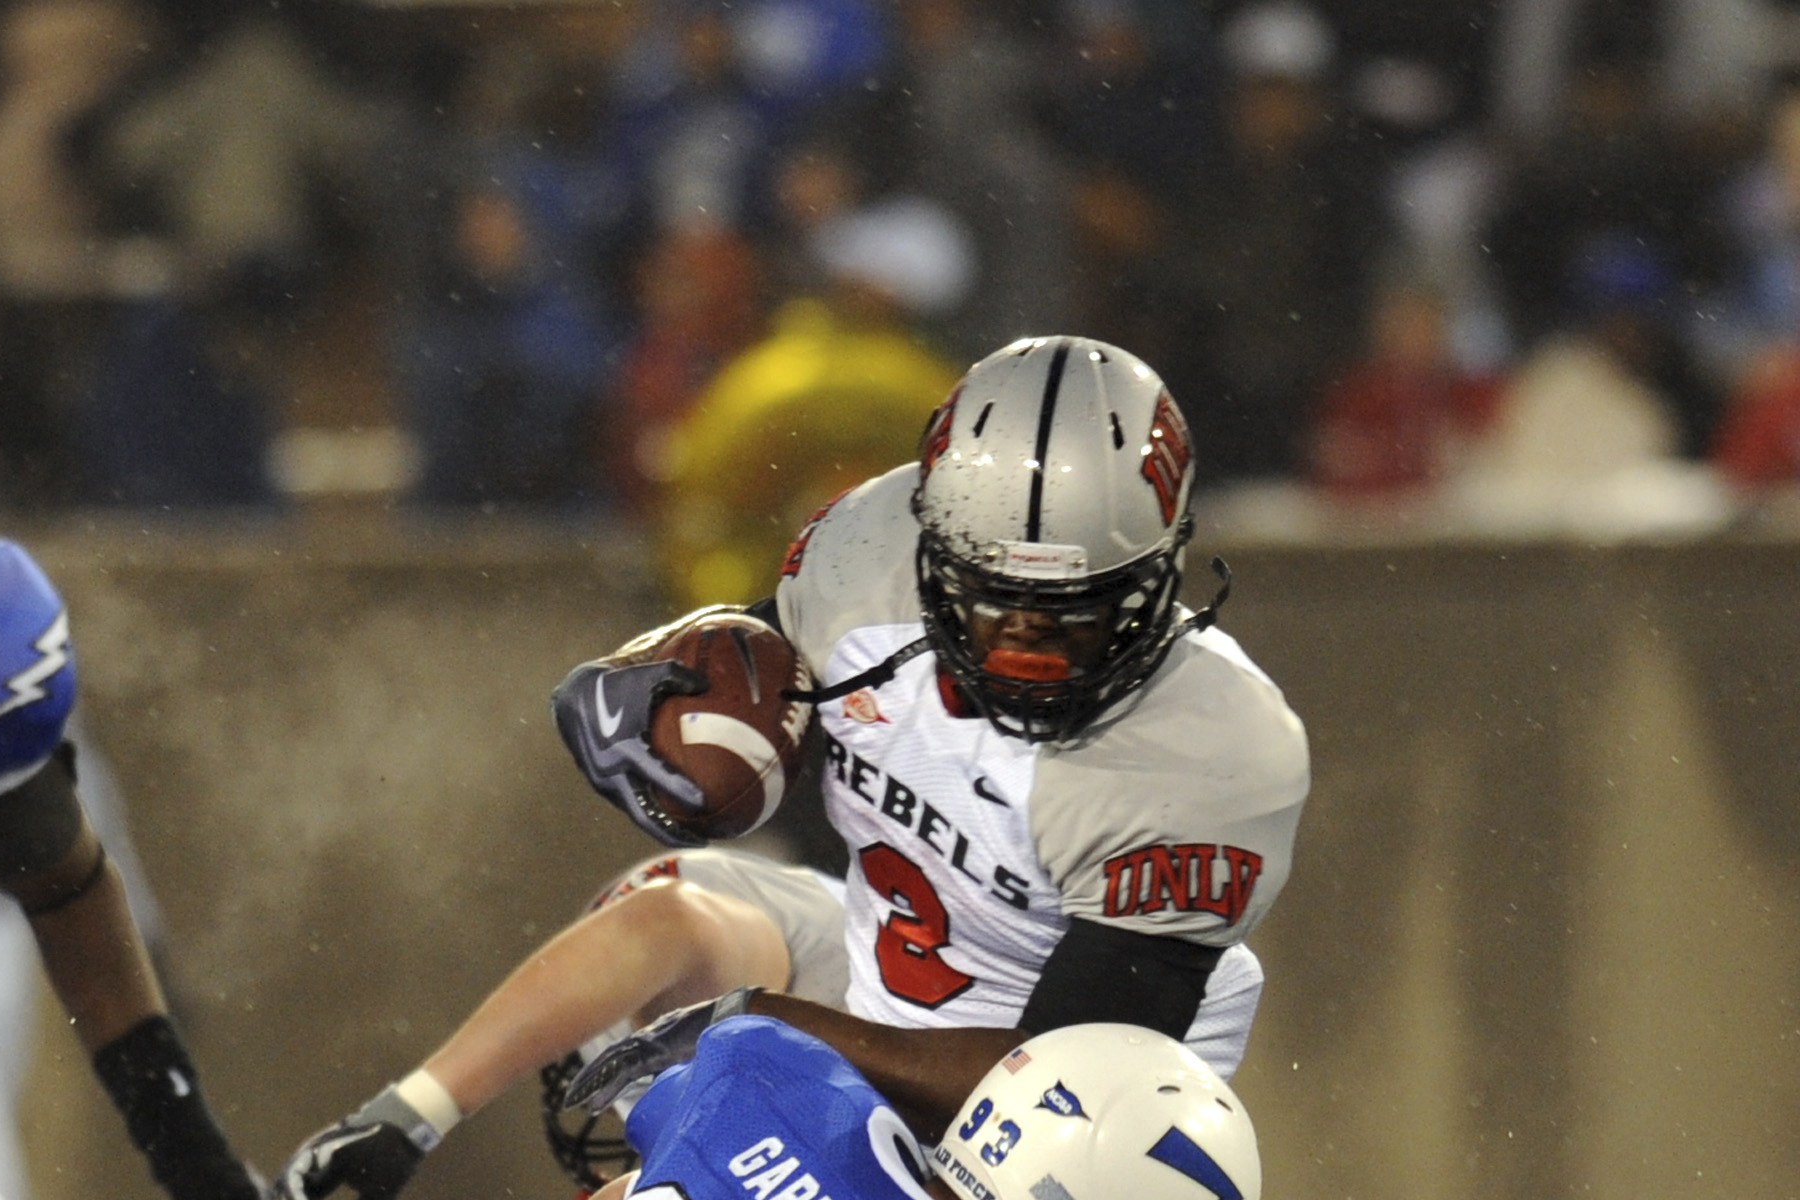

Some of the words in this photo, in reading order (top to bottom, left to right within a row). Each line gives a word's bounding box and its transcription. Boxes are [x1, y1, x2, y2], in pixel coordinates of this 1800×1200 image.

[825, 734, 1031, 911] REBELS
[1103, 843, 1263, 928] UNLV
[958, 1096, 1022, 1168] 93
